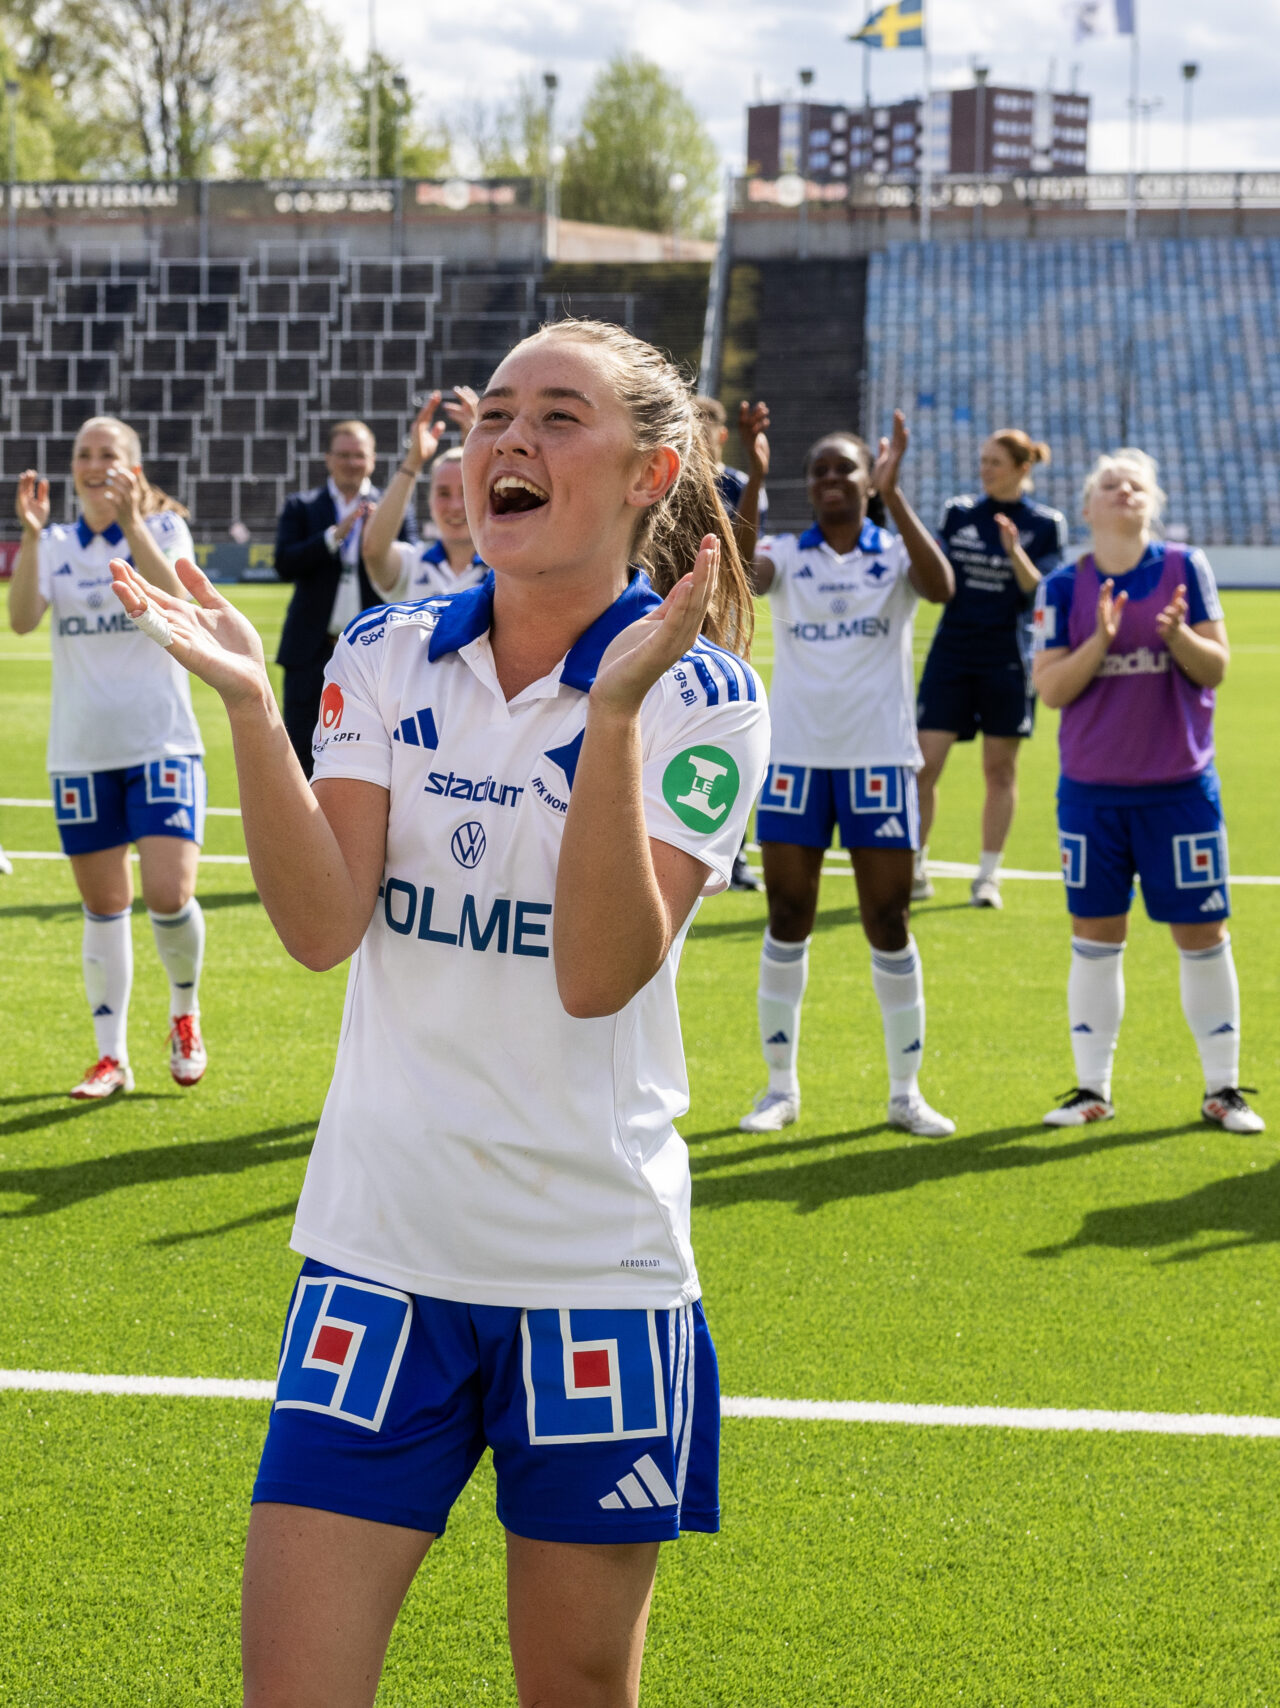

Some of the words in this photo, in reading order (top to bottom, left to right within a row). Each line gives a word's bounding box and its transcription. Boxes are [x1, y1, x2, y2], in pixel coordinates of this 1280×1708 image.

[424, 772, 524, 807] stadium
[531, 776, 548, 797] IFK
[379, 877, 552, 958] OLME
